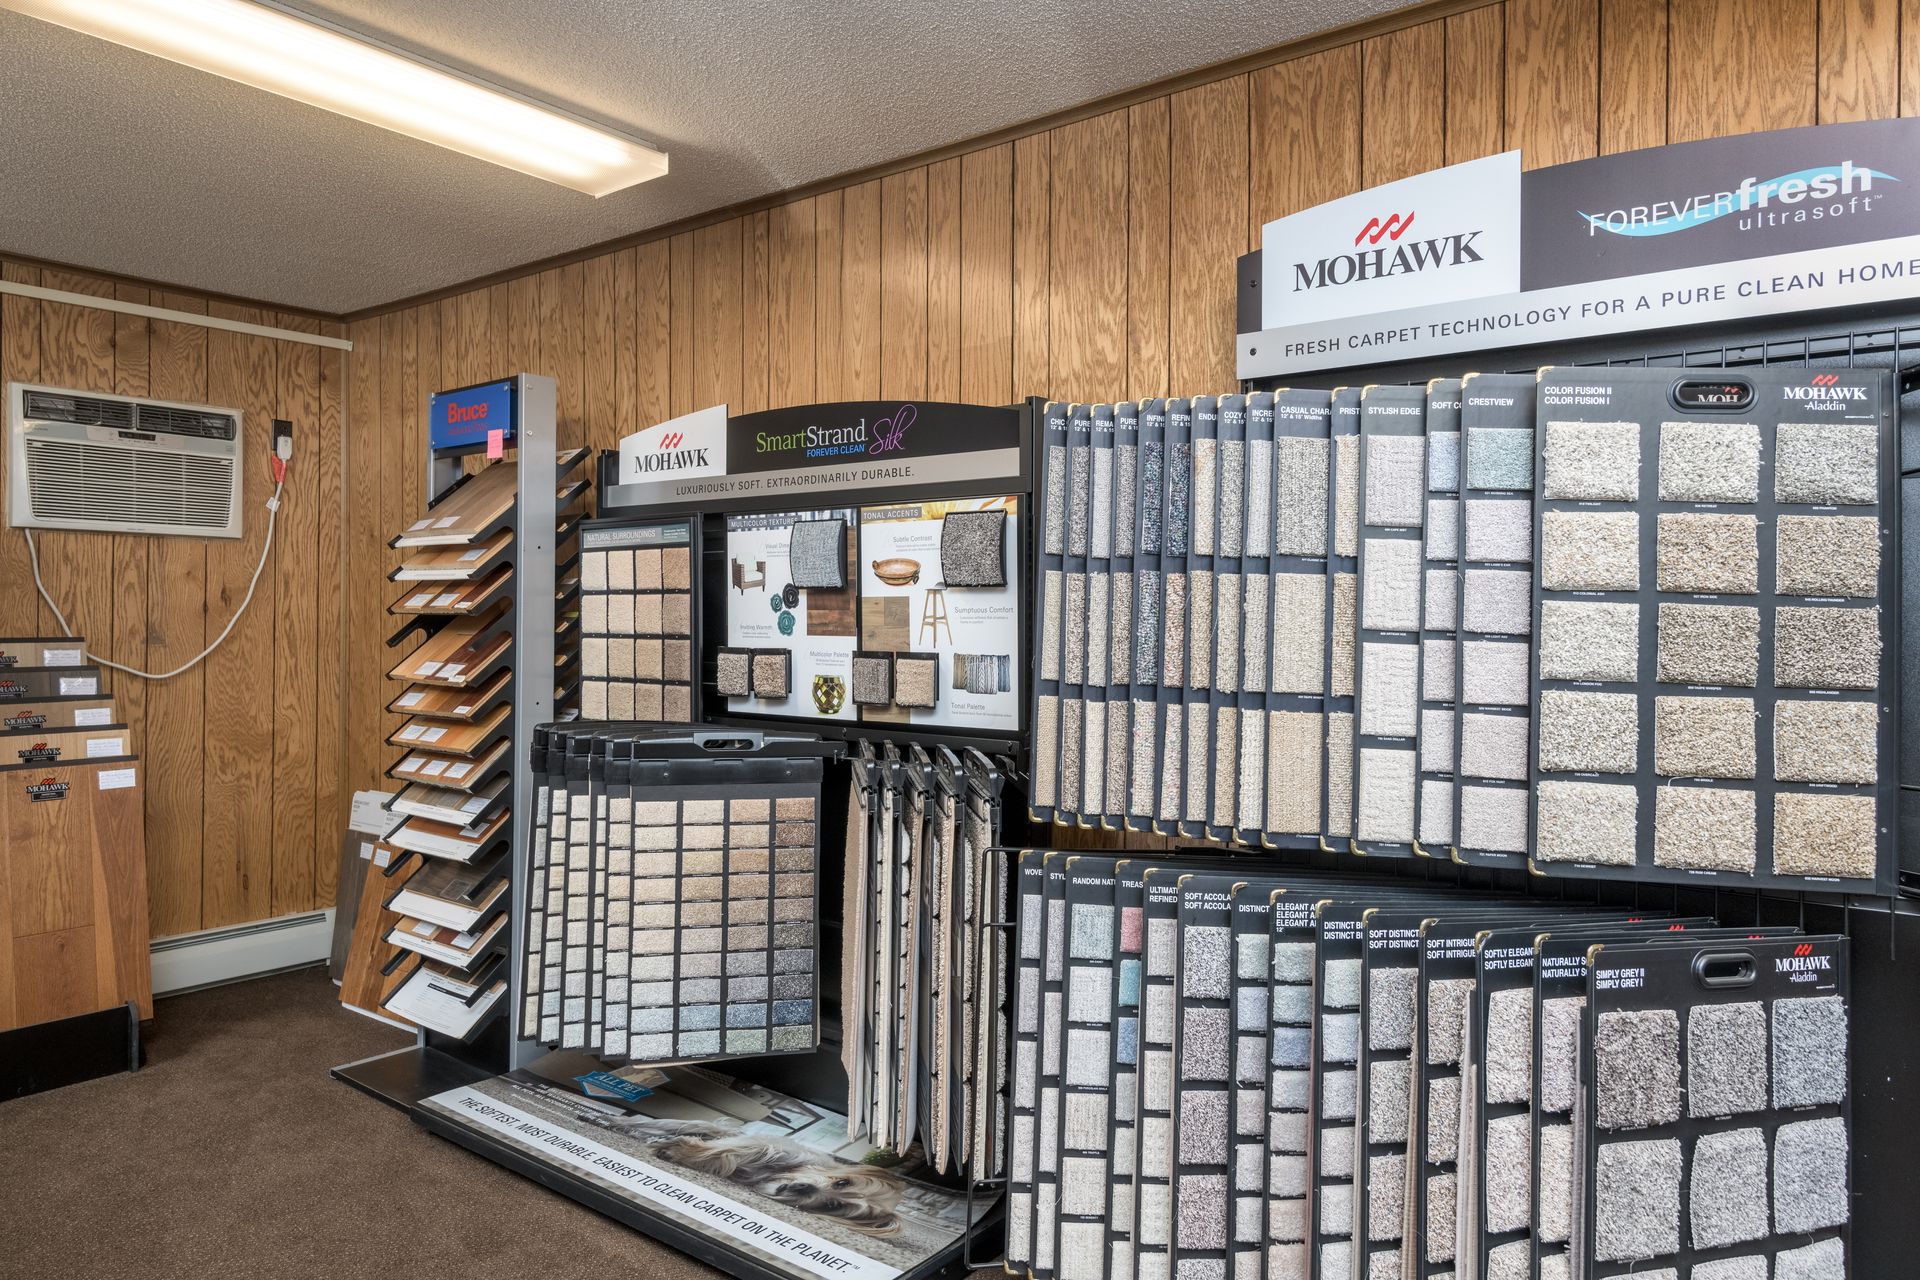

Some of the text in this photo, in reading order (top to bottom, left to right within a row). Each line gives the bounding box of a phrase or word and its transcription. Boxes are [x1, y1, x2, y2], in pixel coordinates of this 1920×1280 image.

[1739, 197, 1872, 231] ultrasoft
[1292, 230, 1484, 292] MOHAWK
[1285, 338, 1340, 357] FRESH
[1348, 326, 1421, 349] CARPET
[1428, 305, 1572, 338] TECHNOLOGY
[1581, 299, 1624, 318] FOR
[1635, 296, 1650, 311] A
[1662, 285, 1726, 307] PURE
[1737, 271, 1824, 297] CLEAN
[1545, 386, 1612, 395] COLOR FUSION II
[1784, 387, 1868, 400] MOHAWK
[1468, 398, 1514, 406] CRESTVIEW
[1545, 396, 1573, 405] COLOR
[1575, 396, 1605, 405] FUSION
[1280, 406, 1308, 414] CASUAL
[1432, 402, 1452, 410] SOFT
[1805, 402, 1846, 411] Aladdin
[448, 402, 488, 424] Bruce
[869, 404, 918, 455] Silk
[806, 444, 865, 458] FOREVER CLEAN
[634, 448, 709, 474] MOHAWK
[676, 466, 914, 496] LUXURIOUSLY SOFT. EXTRAORDINARILY DURABLE.
[864, 510, 919, 520] TONAL ACCENTS
[731, 519, 768, 528] MULTICOLOR
[954, 606, 988, 614] Sumptuous
[4, 716, 46, 726] MOHAWK
[28, 783, 70, 793] MOHAWK
[1389, 940, 1419, 948] DISTINCT
[1427, 938, 1475, 948] SOFT INTRIGUE
[1427, 950, 1476, 959] SOFT INTRIGUE
[1484, 949, 1508, 959] SOFTLY
[1484, 961, 1508, 970] SOFTLY
[1542, 957, 1580, 967] NATURALLY
[1775, 956, 1831, 972] MOHAWK
[1542, 969, 1580, 978] NATURALLY
[1596, 970, 1619, 979] SIMPLY
[1621, 969, 1639, 978] GREY
[1790, 972, 1817, 982] Aladdin
[1596, 980, 1619, 989] SIMPLY
[1621, 979, 1639, 988] GREY
[594, 1074, 644, 1094] ALL PET
[459, 1097, 482, 1109] THE
[515, 1123, 551, 1138] MOST
[593, 1156, 643, 1179] EASIEST
[637, 1176, 658, 1186] TO
[653, 1183, 698, 1204] CLEAN
[693, 1200, 747, 1225] CARPET
[741, 1221, 767, 1235] ON
[764, 1230, 797, 1247] THE
[791, 1242, 852, 1273] PLANET.
